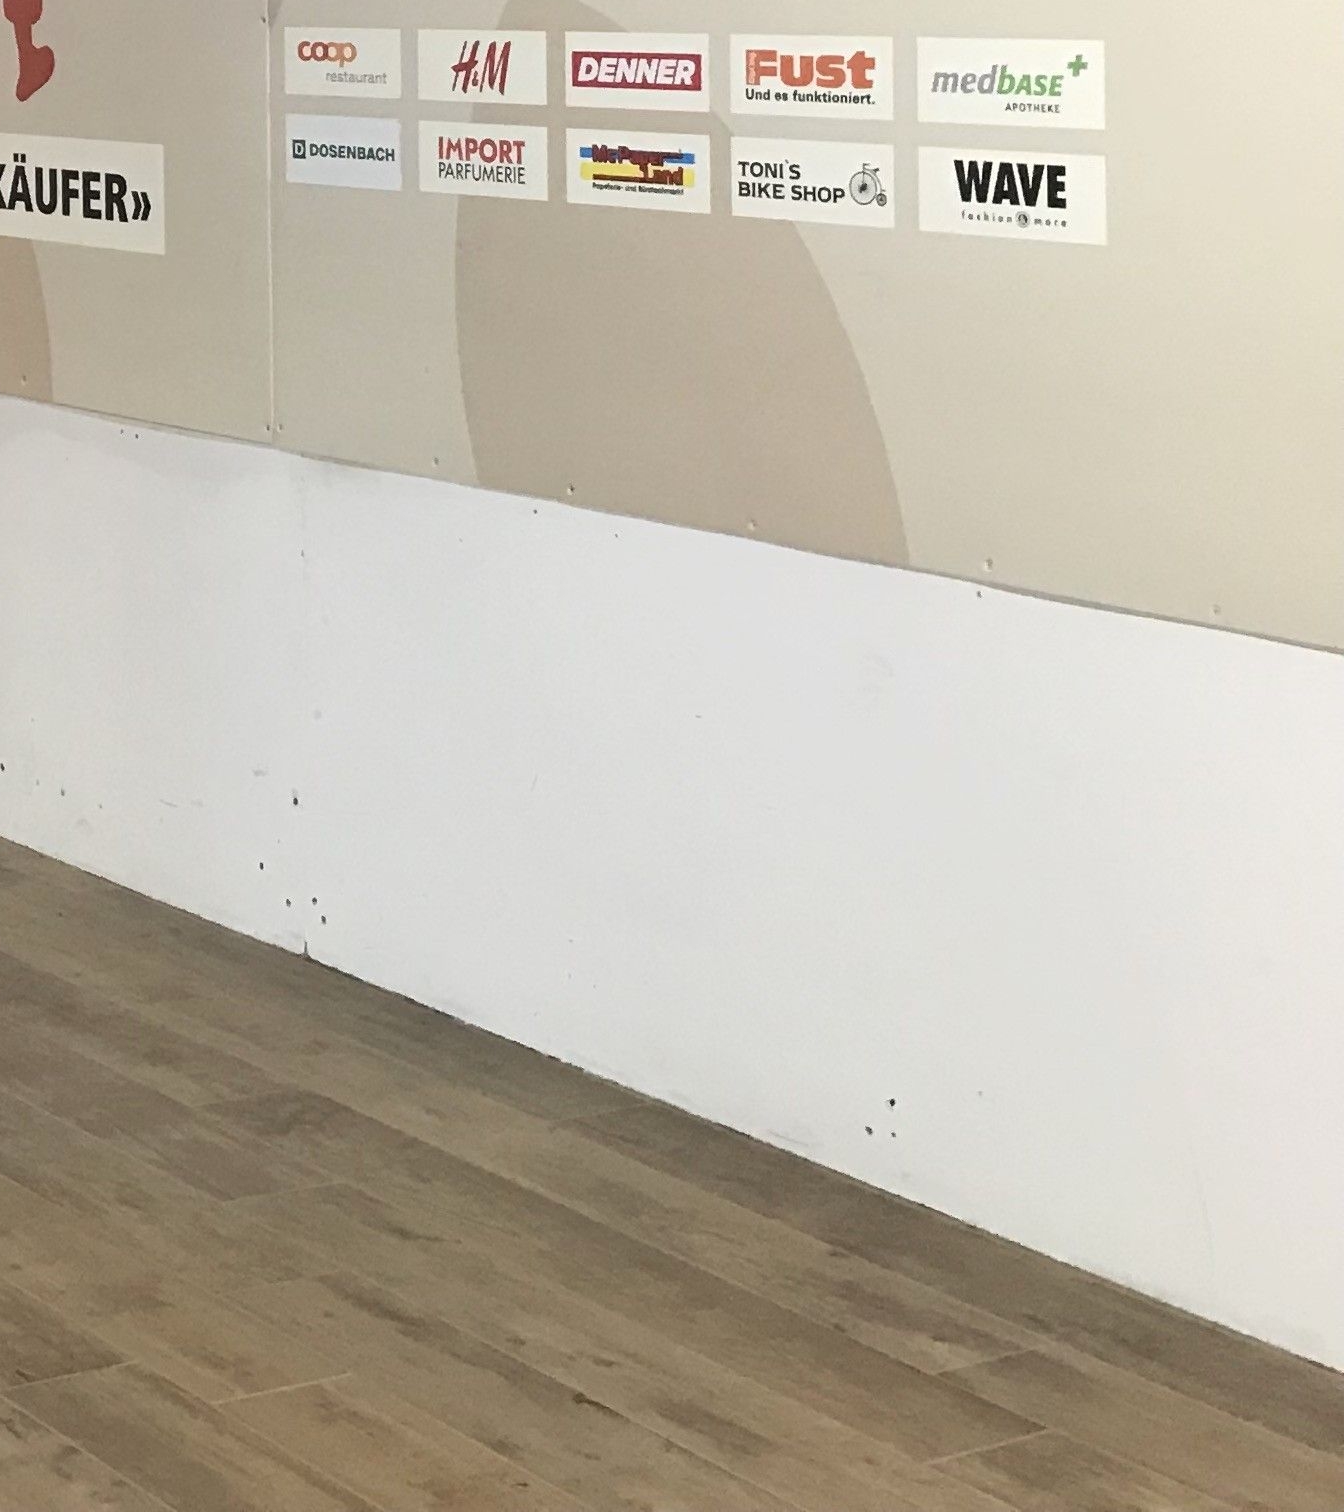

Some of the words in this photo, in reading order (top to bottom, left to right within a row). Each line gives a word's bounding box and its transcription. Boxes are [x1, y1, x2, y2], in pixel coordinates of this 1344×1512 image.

[297, 40, 357, 68] coop
[325, 71, 388, 85] restaurant
[450, 40, 512, 96] H&M
[577, 56, 697, 87] DENNER
[745, 48, 876, 89] Fust
[745, 88, 771, 101] Und
[774, 91, 789, 102] es
[792, 90, 876, 105] funktioniert.
[1004, 102, 1061, 114] APOTHEKE
[309, 143, 396, 162] DOSENBACH
[438, 136, 526, 165] IMPORT
[438, 161, 526, 185] PARFUMERIE
[953, 159, 1067, 210] WAVE
[738, 180, 785, 200] BIKE
[791, 185, 846, 204] SHOP
